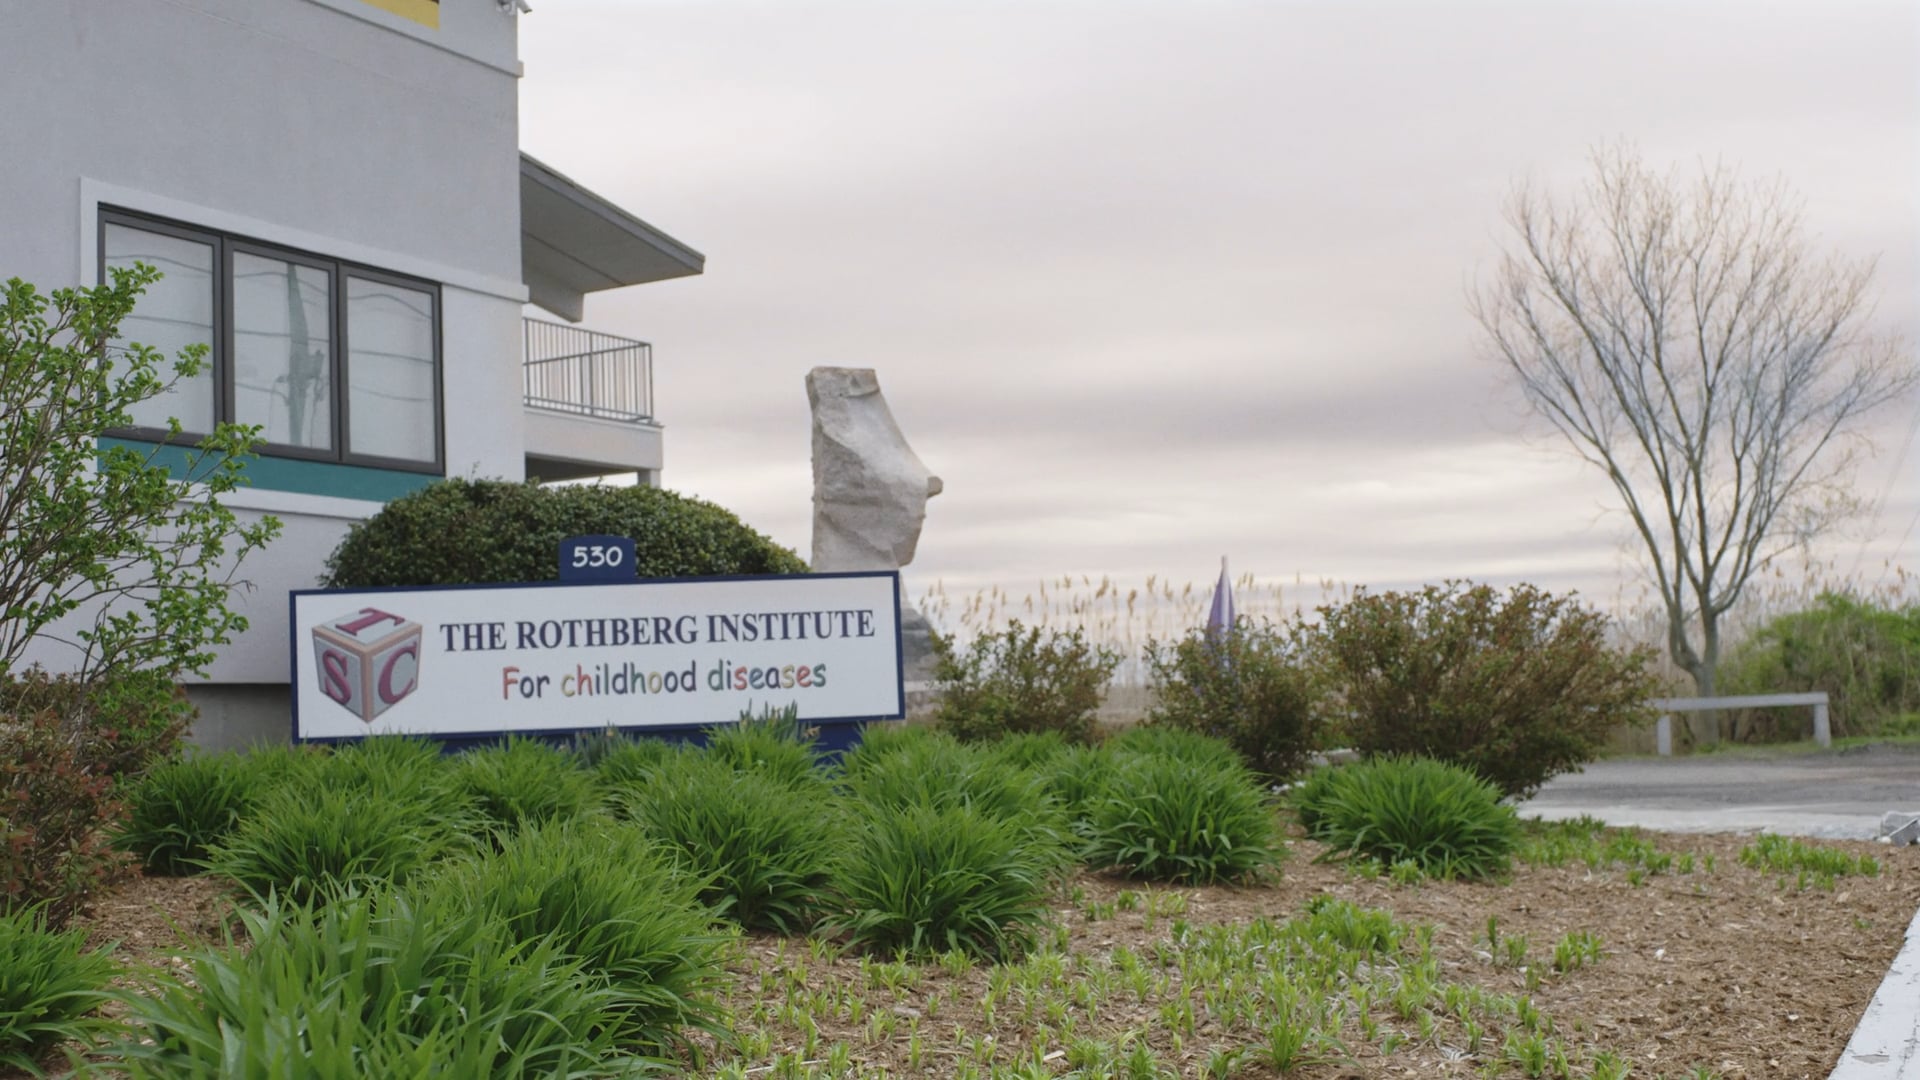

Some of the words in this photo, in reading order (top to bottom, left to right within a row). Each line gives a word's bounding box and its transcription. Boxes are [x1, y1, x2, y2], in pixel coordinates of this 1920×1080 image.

[571, 545, 623, 569] 530
[334, 606, 406, 637] T
[439, 622, 508, 652] THE
[515, 615, 699, 649] ROTHBERG
[706, 609, 876, 643] INSTITUTE
[321, 649, 353, 706] S
[377, 641, 418, 705] C
[502, 665, 551, 700] For
[560, 659, 697, 698] childhood
[707, 658, 827, 691] diseases
